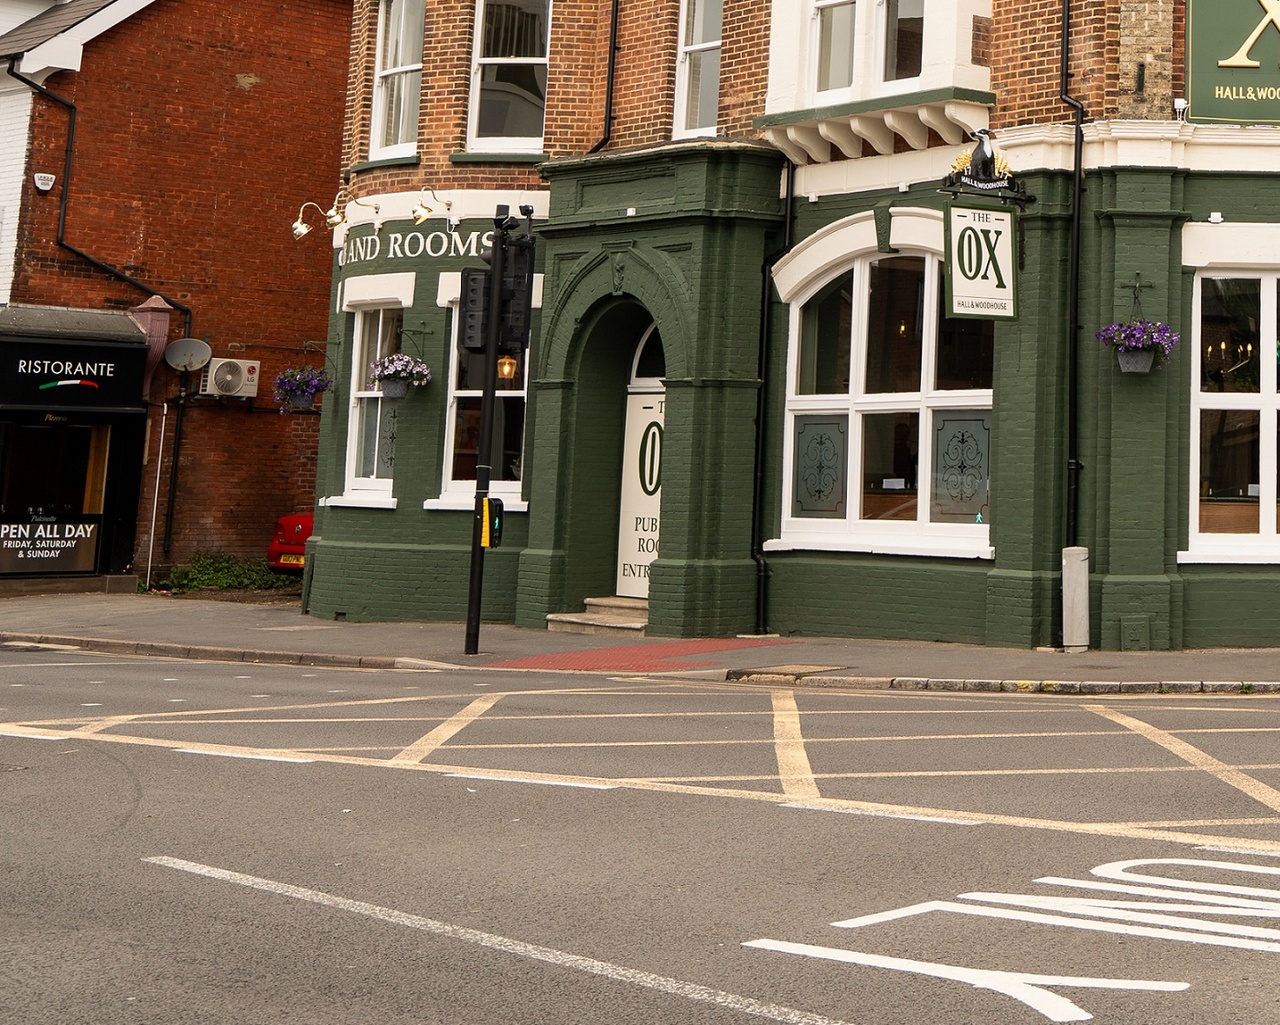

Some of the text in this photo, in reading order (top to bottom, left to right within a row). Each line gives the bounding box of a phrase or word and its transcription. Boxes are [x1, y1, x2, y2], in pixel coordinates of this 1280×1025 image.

[971, 212, 991, 223] THE
[347, 235, 381, 264] AND
[957, 226, 1007, 289] OX
[957, 300, 1007, 311] HALL&WOODHOUSE
[18, 359, 115, 377] RISTORANTE
[0, 524, 95, 538] PEN ALL DAY
[634, 517, 658, 532] PUB
[3, 540, 77, 549] FRIDAY, SATURDAY
[17, 549, 61, 558] & SUNDAY
[622, 563, 650, 578] ENTR
